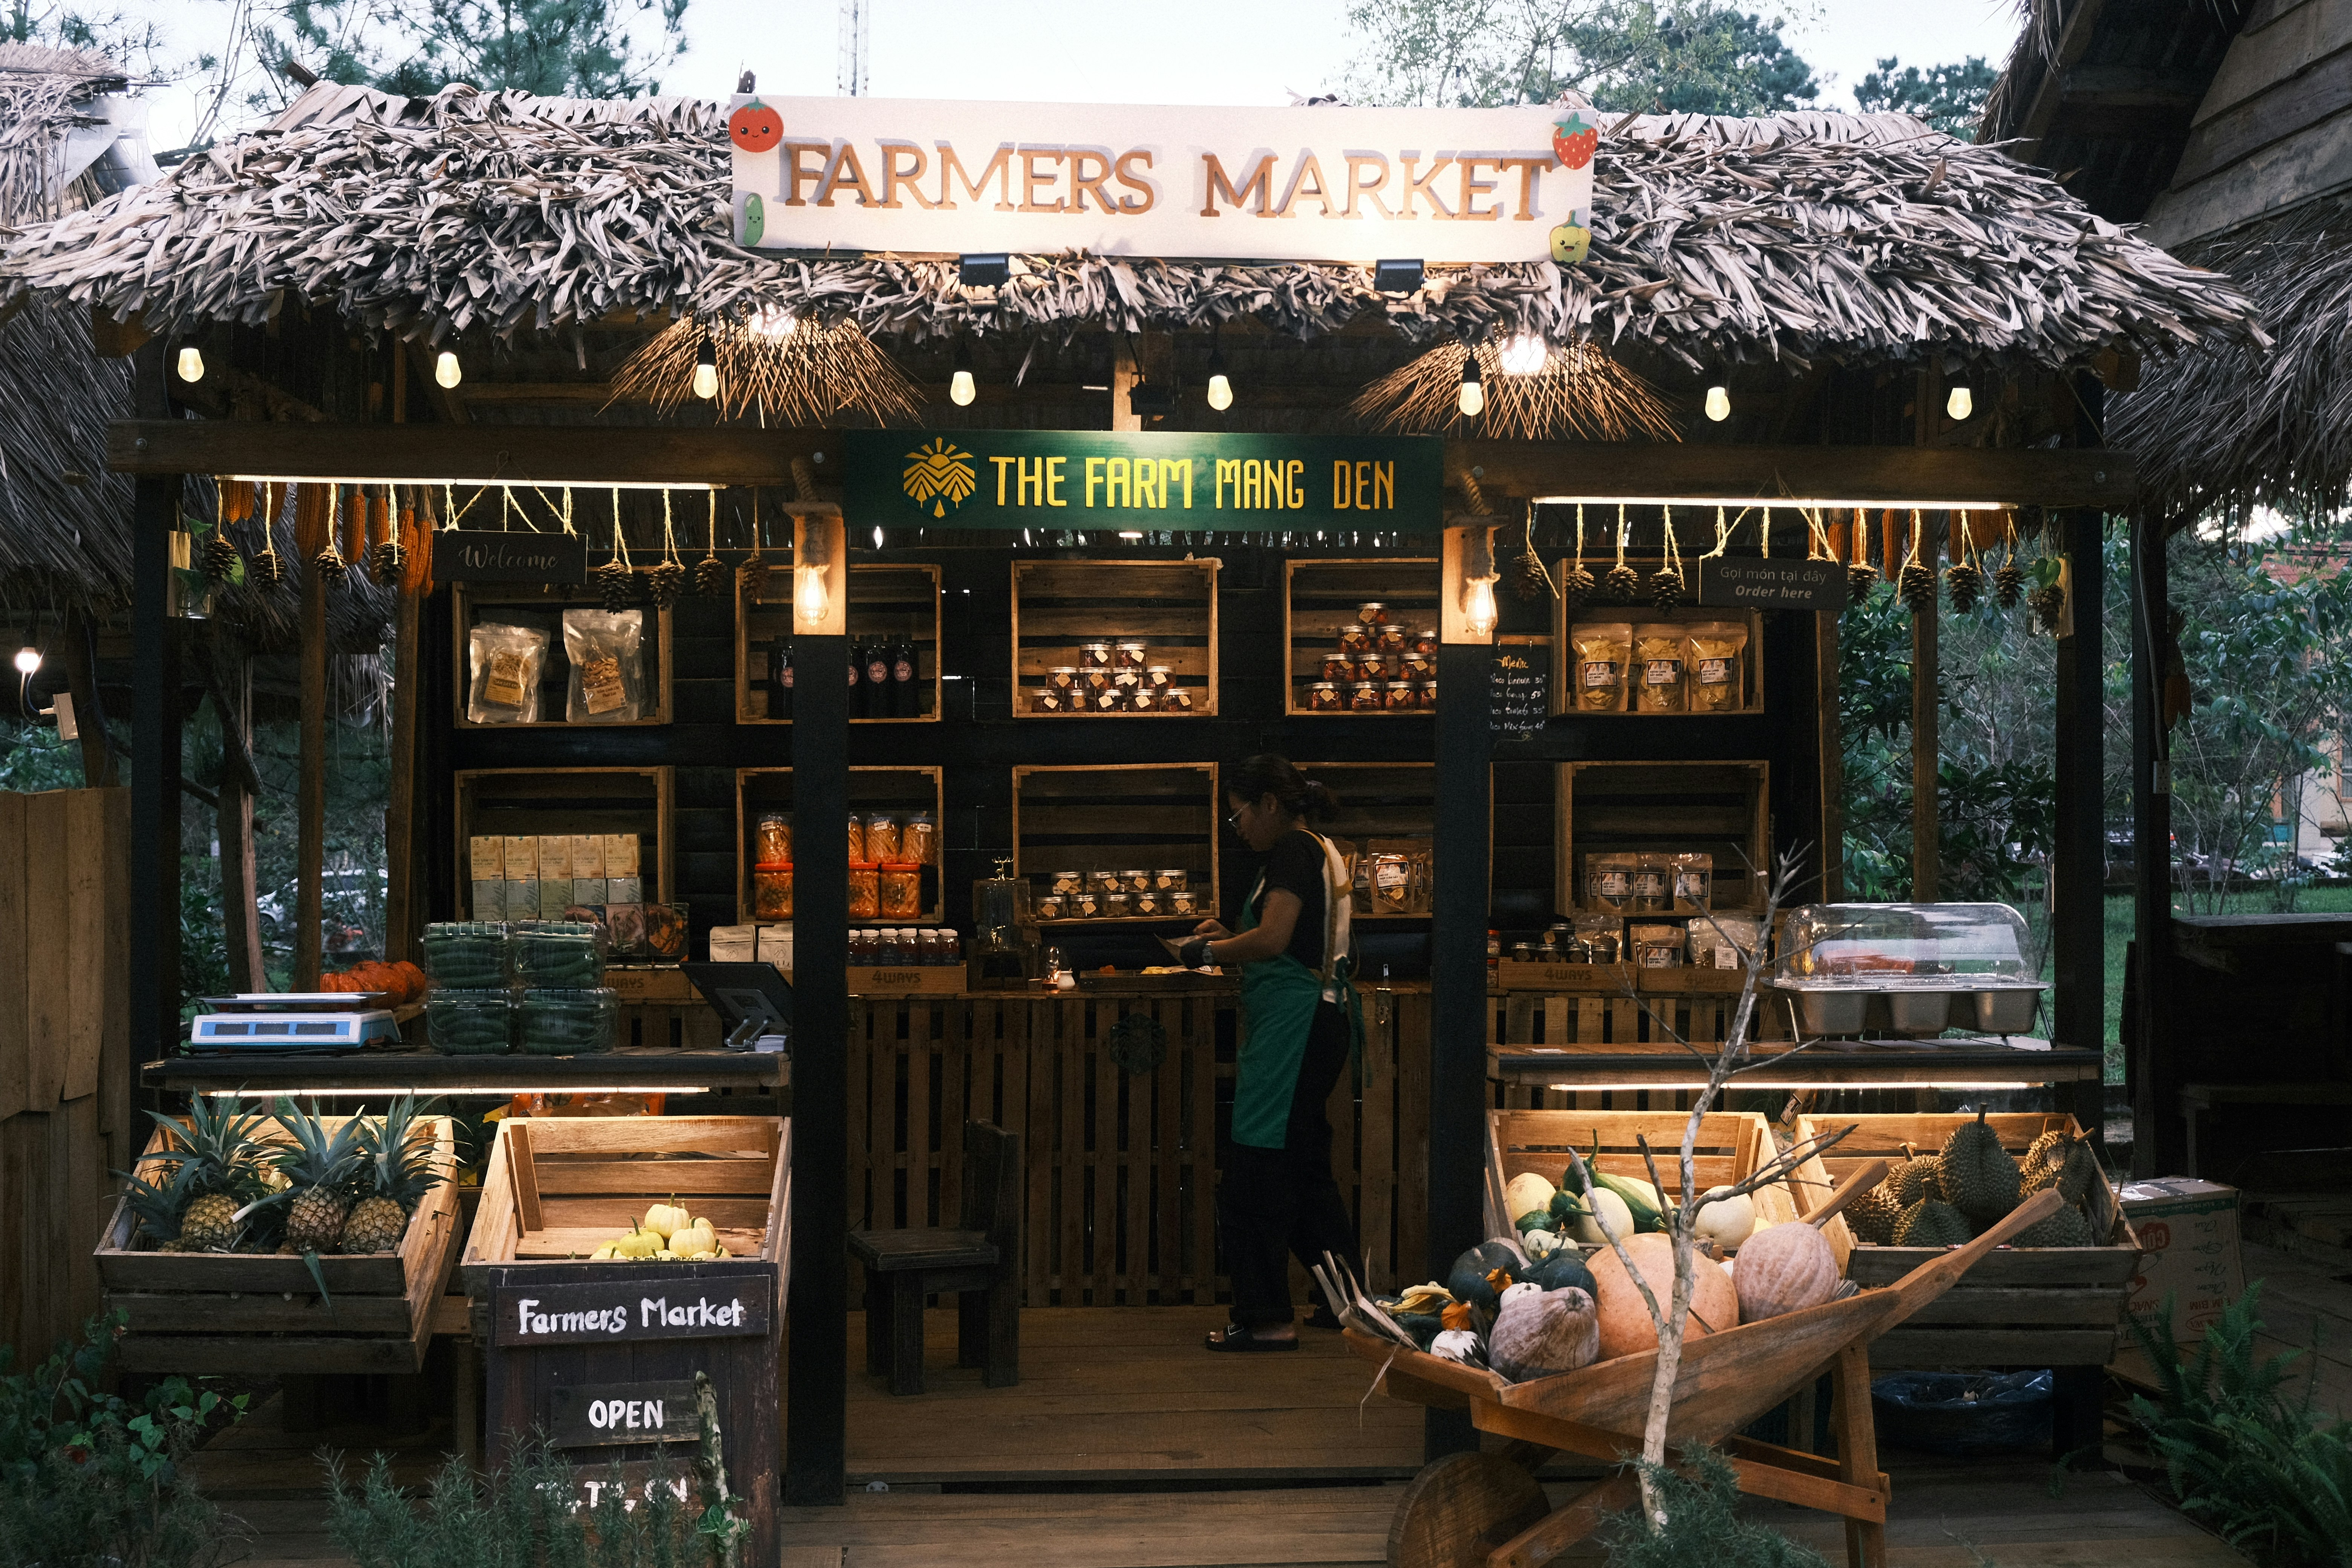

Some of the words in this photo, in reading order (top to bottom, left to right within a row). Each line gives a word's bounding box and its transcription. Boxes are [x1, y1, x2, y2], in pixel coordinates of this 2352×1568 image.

[785, 142, 1156, 215] FARMERS
[1200, 152, 1551, 222] MARKET
[989, 456, 1067, 507] THE
[1085, 456, 1193, 508] FARM
[1215, 459, 1304, 509] MANG
[1334, 460, 1395, 510] DEN
[458, 544, 559, 570] Welcome
[1720, 567, 1741, 580] Gọi
[1747, 568, 1775, 580] món
[1781, 570, 1797, 583] tại
[1803, 571, 1826, 585] đây
[1735, 585, 1775, 597] Order
[1781, 586, 1812, 599] here
[604, 978, 644, 988] WAYS
[872, 970, 921, 983] 4WAYS
[1544, 968, 1592, 980] 4WAYS
[2190, 1300, 2208, 1310] BIM
[518, 1298, 627, 1335] Farmers
[640, 1296, 744, 1328] Market
[588, 1399, 664, 1429] OPEN
